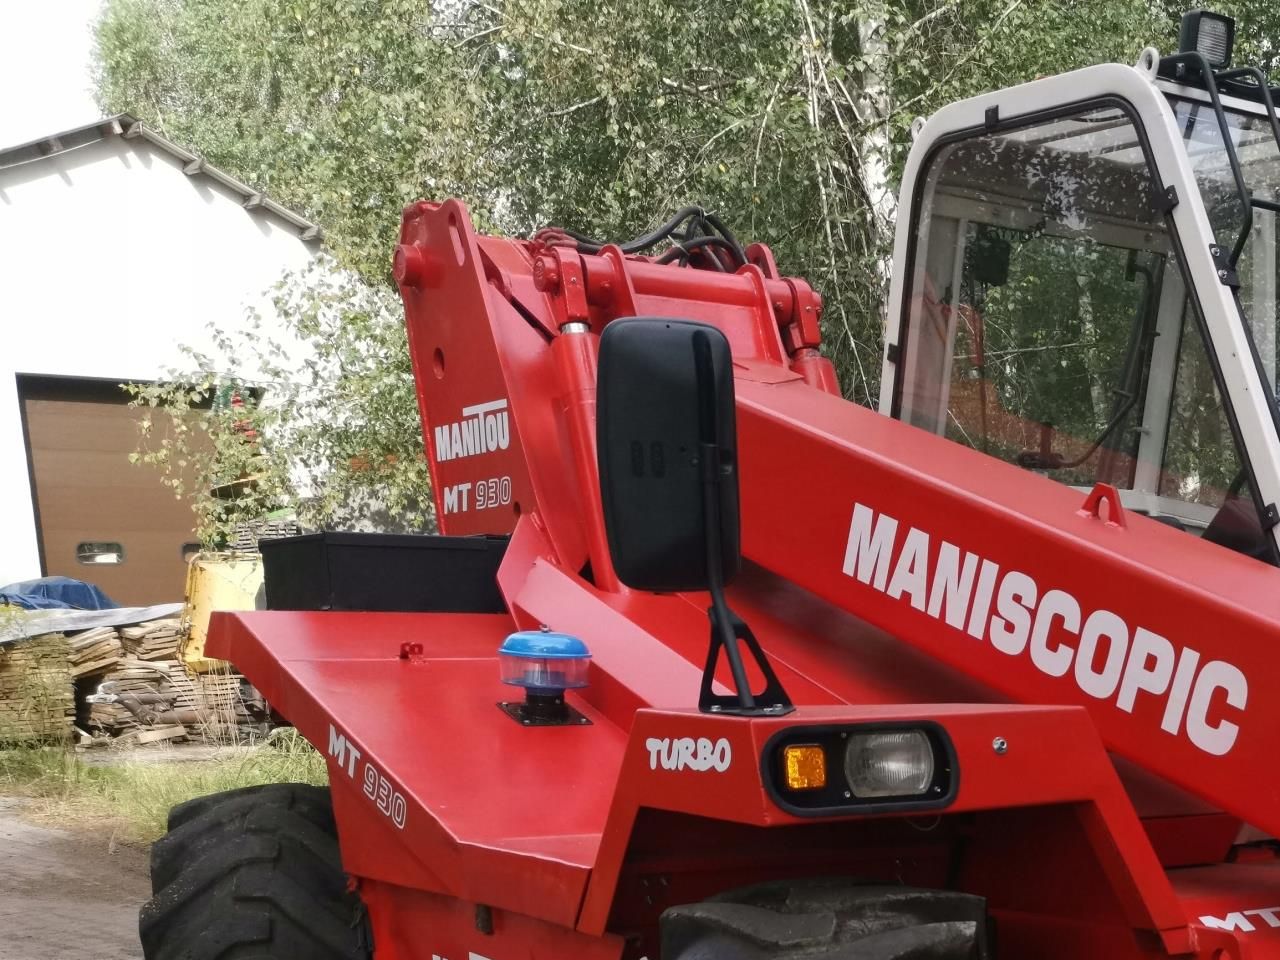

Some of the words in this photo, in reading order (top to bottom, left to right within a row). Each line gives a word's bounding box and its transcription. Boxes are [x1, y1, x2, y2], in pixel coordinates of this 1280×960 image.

[434, 398, 510, 462] MANITOU
[443, 482, 472, 515] MT
[475, 476, 512, 510] 930
[841, 501, 1249, 757] MANISCOPIC
[327, 722, 361, 780] MT
[362, 762, 407, 830] 930
[646, 738, 732, 774] TURBO
